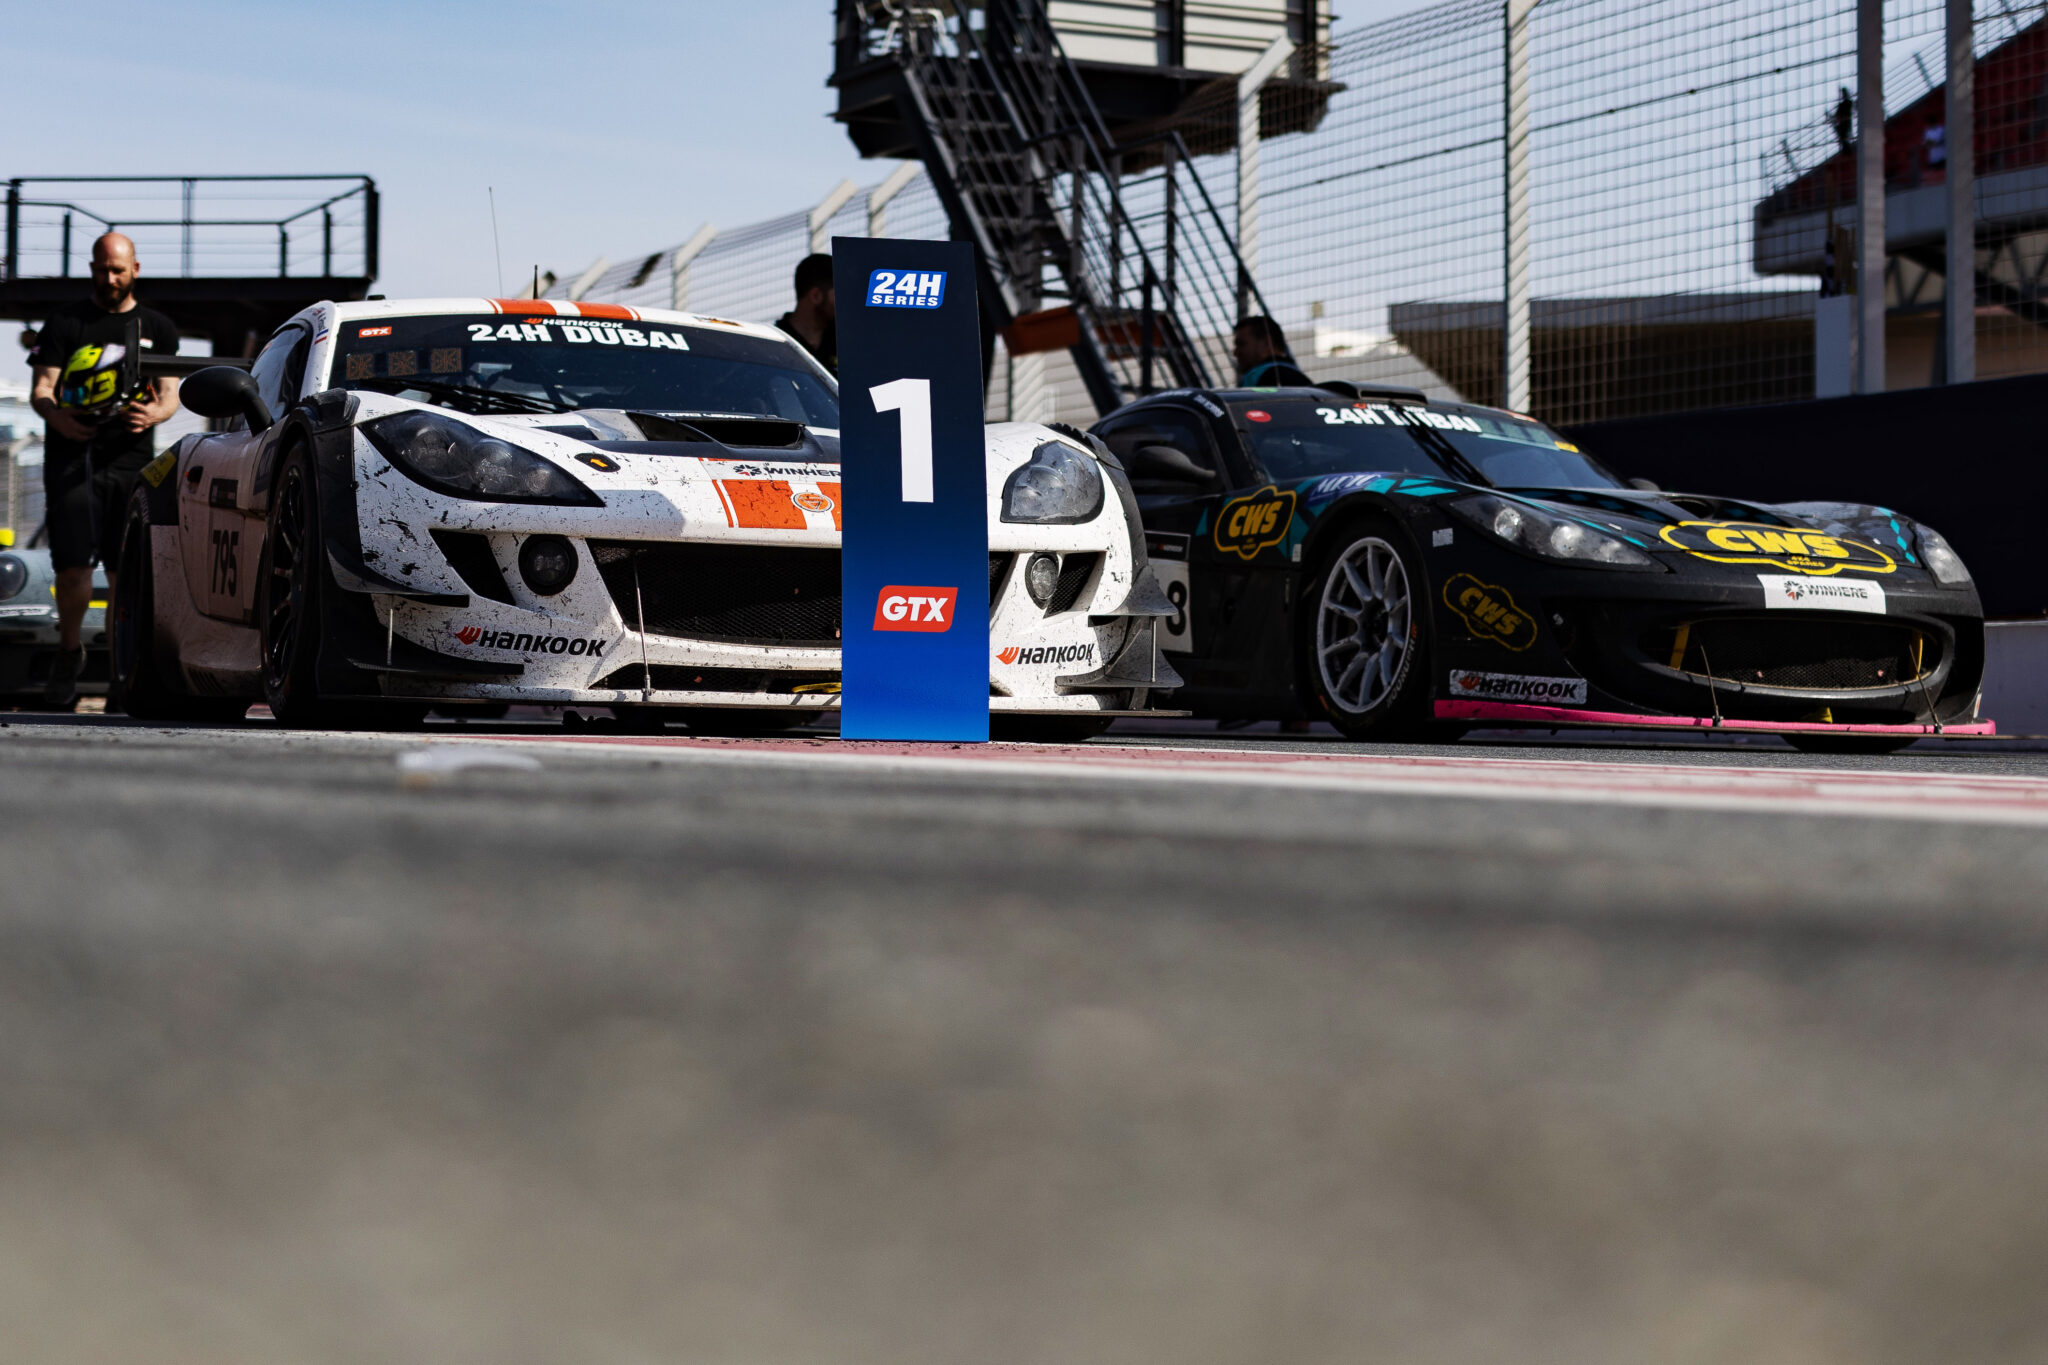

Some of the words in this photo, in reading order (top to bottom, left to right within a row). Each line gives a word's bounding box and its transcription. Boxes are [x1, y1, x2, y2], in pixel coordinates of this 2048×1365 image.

[873, 272, 942, 296] 24H
[871, 295, 938, 306] SERIES
[361, 328, 389, 336] GTX
[467, 324, 552, 341] 24H
[562, 326, 690, 351] DUBAI
[1315, 408, 1385, 425] 24H
[868, 378, 934, 503] 1
[1228, 501, 1284, 538] CWS
[1706, 528, 1850, 559] CWS
[212, 529, 240, 597] 795
[1805, 584, 1868, 599] WINHERE
[882, 595, 948, 622] GTX
[1459, 587, 1522, 636] CWS
